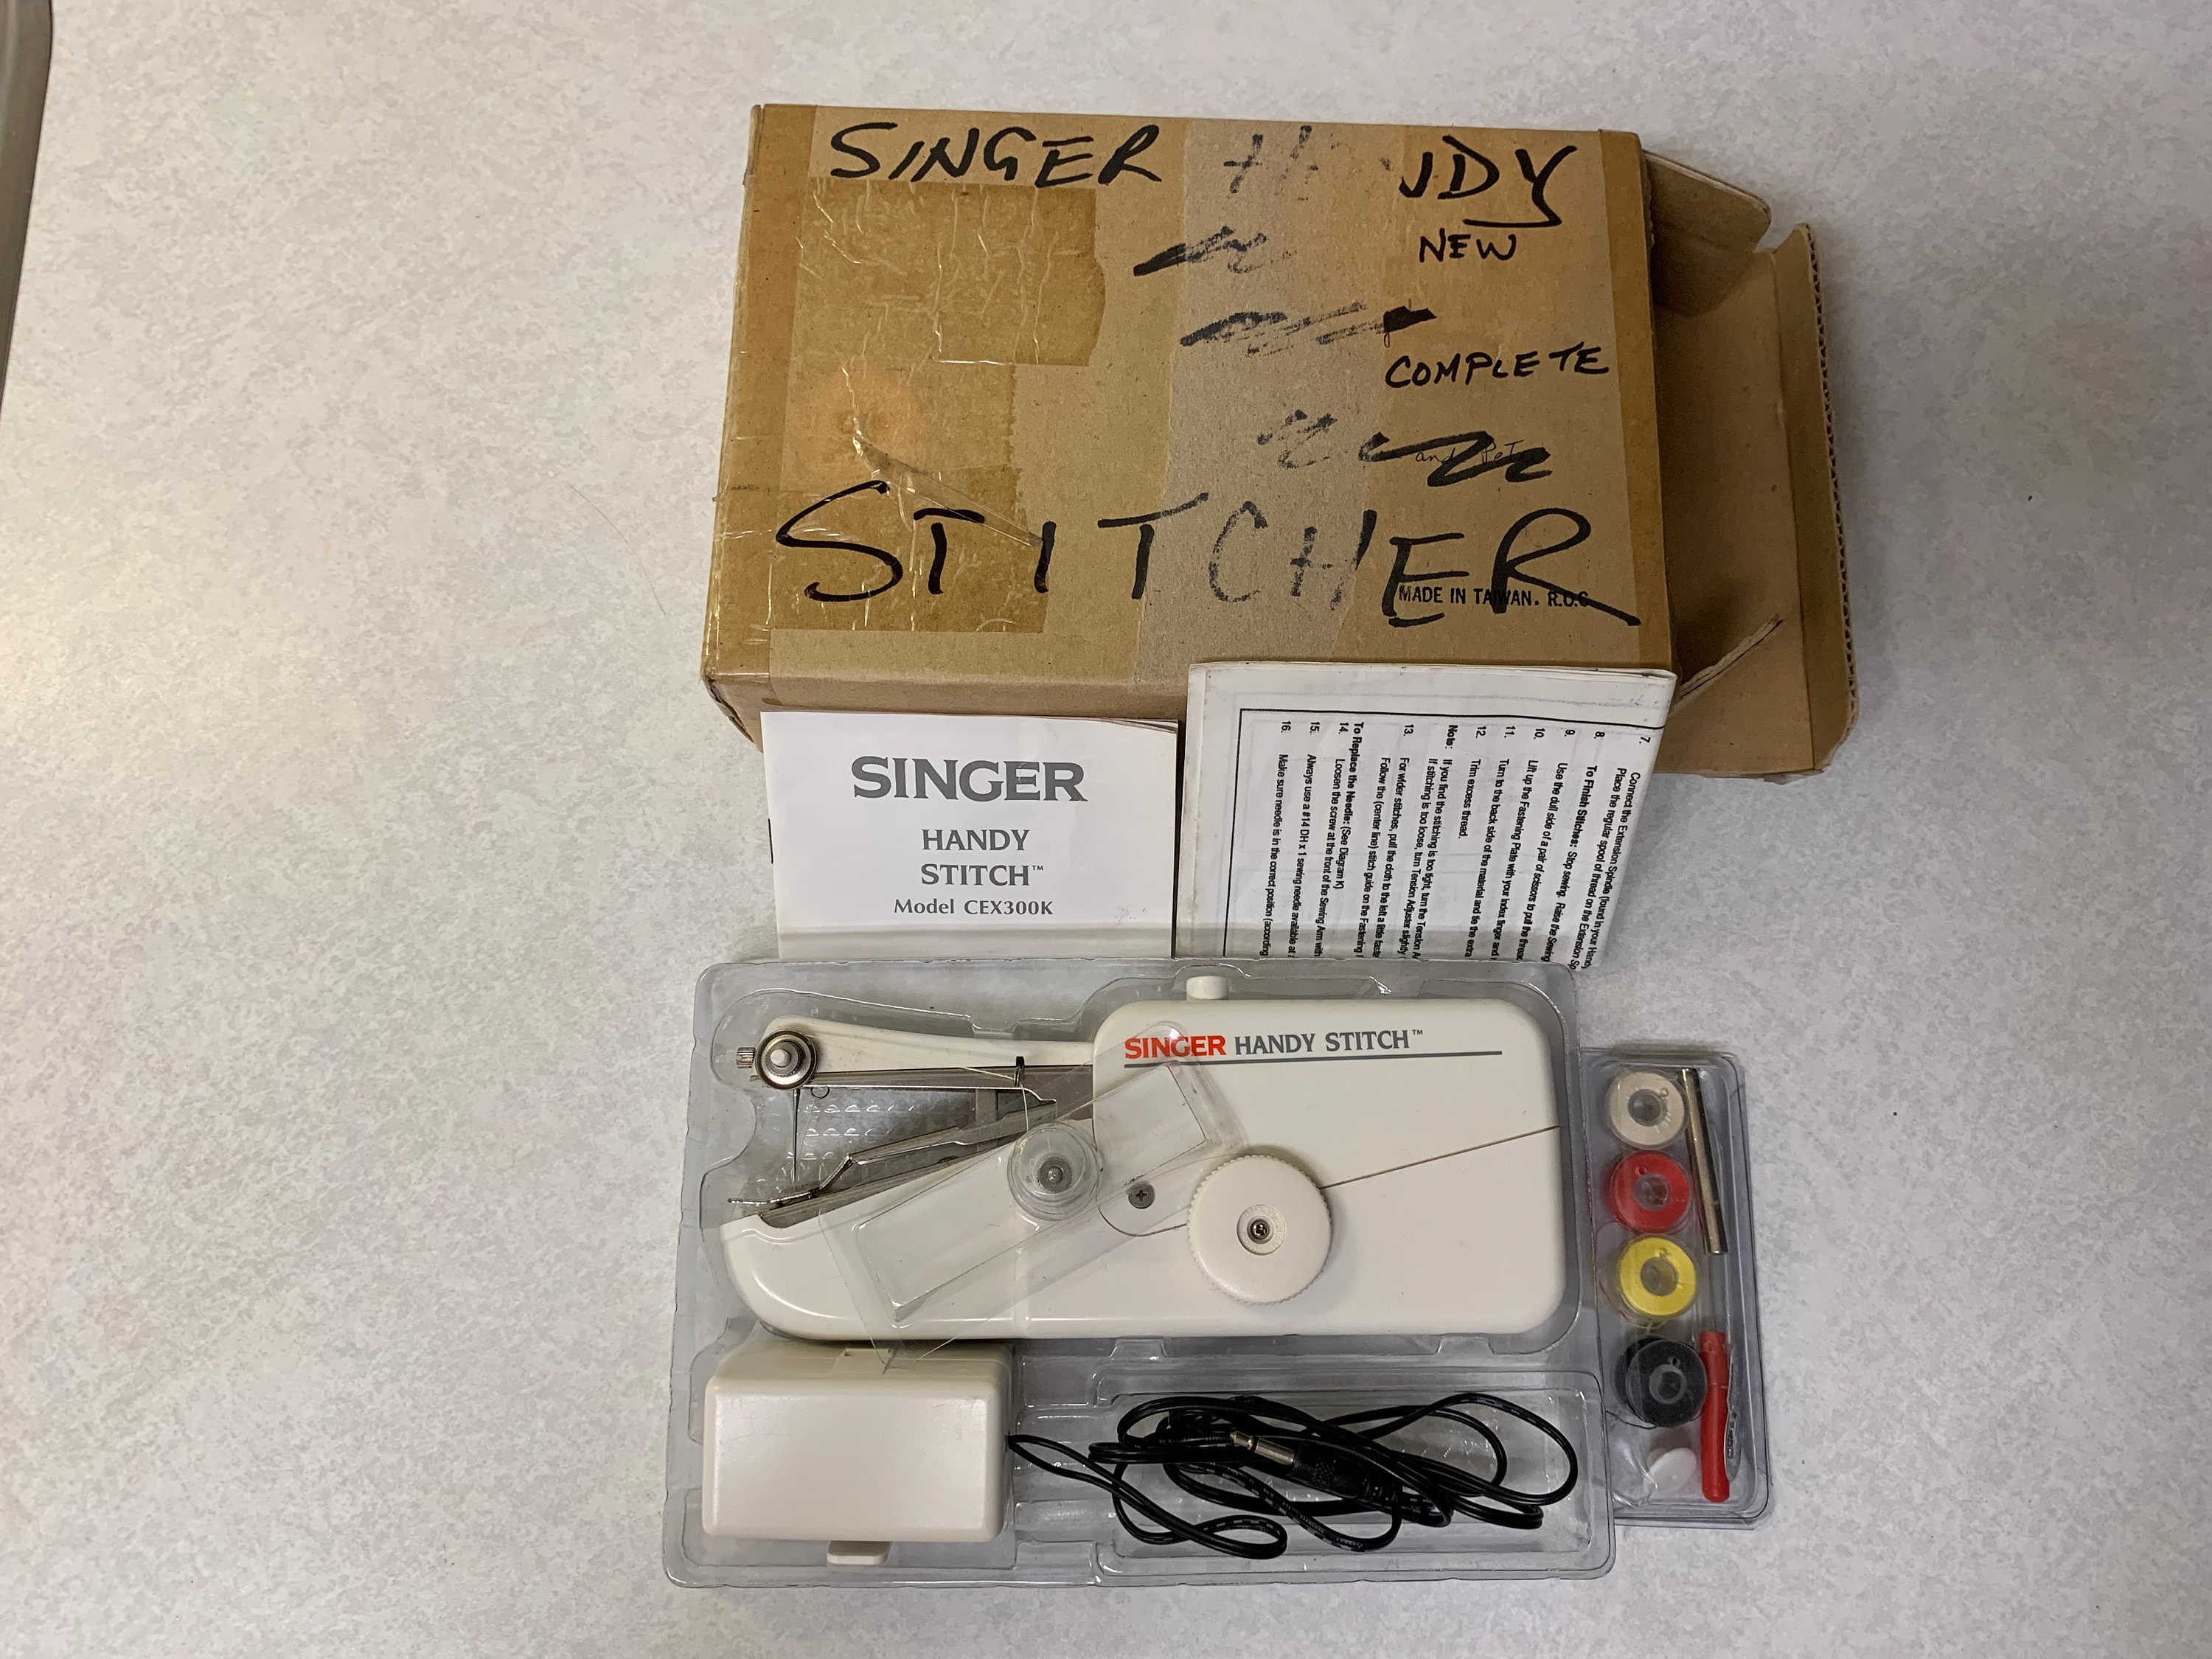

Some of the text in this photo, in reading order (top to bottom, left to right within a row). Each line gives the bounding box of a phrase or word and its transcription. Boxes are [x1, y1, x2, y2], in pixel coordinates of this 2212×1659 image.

[830, 122, 1163, 187] SINGER
[1420, 228, 1517, 262] NEW
[1384, 341, 1609, 388] COMPLETE
[776, 481, 1644, 627] STITCHER
[1399, 585, 1443, 603] MADE
[1450, 588, 1466, 605] IN
[1473, 588, 1540, 606] TAAN.
[1310, 721, 1321, 736] 15.
[1403, 724, 1414, 737] 13.
[1444, 724, 1458, 749] Note:
[1534, 728, 1545, 740] 10.
[1564, 729, 1575, 737] 9.
[1303, 754, 1317, 785] Always
[1378, 757, 1391, 785] Follow
[1399, 757, 1410, 772] For
[1526, 759, 1539, 773] Lift
[1555, 762, 1568, 780] Use
[851, 756, 1088, 802] SINGER
[1439, 766, 1450, 782] you
[1458, 726, 1487, 839] 12. Trim excess thread.
[1522, 774, 1534, 785] up
[1613, 768, 1627, 793] Place
[1303, 786, 1312, 802] use
[1376, 786, 1386, 799] the
[1395, 773, 1407, 797] wider
[1437, 783, 1449, 799] find
[1521, 787, 1533, 800] the
[1551, 782, 1564, 796] the
[1623, 772, 1641, 808] Connect
[1332, 721, 1364, 889] To Replace the Needle: (See Diagram K)
[1435, 801, 1446, 815] the
[1548, 796, 1560, 812] dull
[1609, 794, 1621, 808] the
[1301, 811, 1311, 827] #14
[1372, 801, 1385, 830] (center
[1388, 798, 1403, 832] stitches,
[1510, 801, 1531, 841] Fastening
[1544, 812, 1557, 830] side
[1620, 810, 1632, 824] the
[1427, 815, 1442, 849] stitching
[1601, 810, 1615, 839] regular
[921, 829, 1030, 851] HANDY
[1258, 720, 1292, 957] 16. Make sure needle the correct position (according
[1299, 829, 1310, 843] DH
[1312, 722, 1349, 958] 14. Loosen the screw at the front the Sewing Arm with
[1367, 832, 1381, 849] line)
[1387, 833, 1398, 849] pull
[1464, 726, 1516, 959] 11. Turn the back side the material and tie the extra
[1542, 830, 1552, 841] of
[1509, 842, 1522, 863] Plate
[1541, 731, 1605, 962] 8. To Finish Stitches: Stop sewing. Raise the Sewing
[1596, 840, 1608, 863] spool
[1610, 825, 1628, 865] Extension
[1366, 850, 1378, 872] stitch
[1386, 850, 1397, 863] the
[1397, 765, 1436, 956] stitching too loose, turn Tension Adjuster slightly
[1537, 847, 1548, 864] pair
[1293, 858, 1305, 885] sewing
[1383, 863, 1394, 882] cloth
[1425, 858, 1436, 872] too
[1505, 863, 1516, 879] with
[1593, 863, 1604, 873] of
[1363, 872, 1374, 893] guide
[1421, 872, 1434, 891] tight,
[1501, 880, 1512, 897] your
[1528, 874, 1543, 902] scissors
[1587, 873, 1601, 898] thread
[1602, 866, 1618, 895] Spindle
[1292, 886, 1302, 911] needle
[1380, 891, 1391, 904] the
[1419, 892, 1430, 907] turn
[1585, 898, 1594, 909] on
[894, 898, 1054, 916] Model CEX300K
[1360, 905, 1371, 917] the
[1377, 905, 1389, 917] left
[1417, 908, 1428, 920] the
[1498, 898, 1510, 919] index
[1581, 909, 1593, 922] the
[1523, 911, 1534, 925] pull
[1593, 920, 1604, 929] in
[1289, 912, 1299, 945] available
[1353, 917, 1369, 954] Fastening
[1374, 924, 1386, 939] little
[1413, 921, 1426, 950] Tension
[1492, 919, 1506, 941] finger
[1520, 926, 1531, 938] the
[1589, 928, 1600, 946] your
[1491, 942, 1500, 957] and
[1572, 923, 1590, 959] Extension
[1124, 1034, 1226, 1059] SINGER
[1235, 1033, 1315, 1055] HANDY
